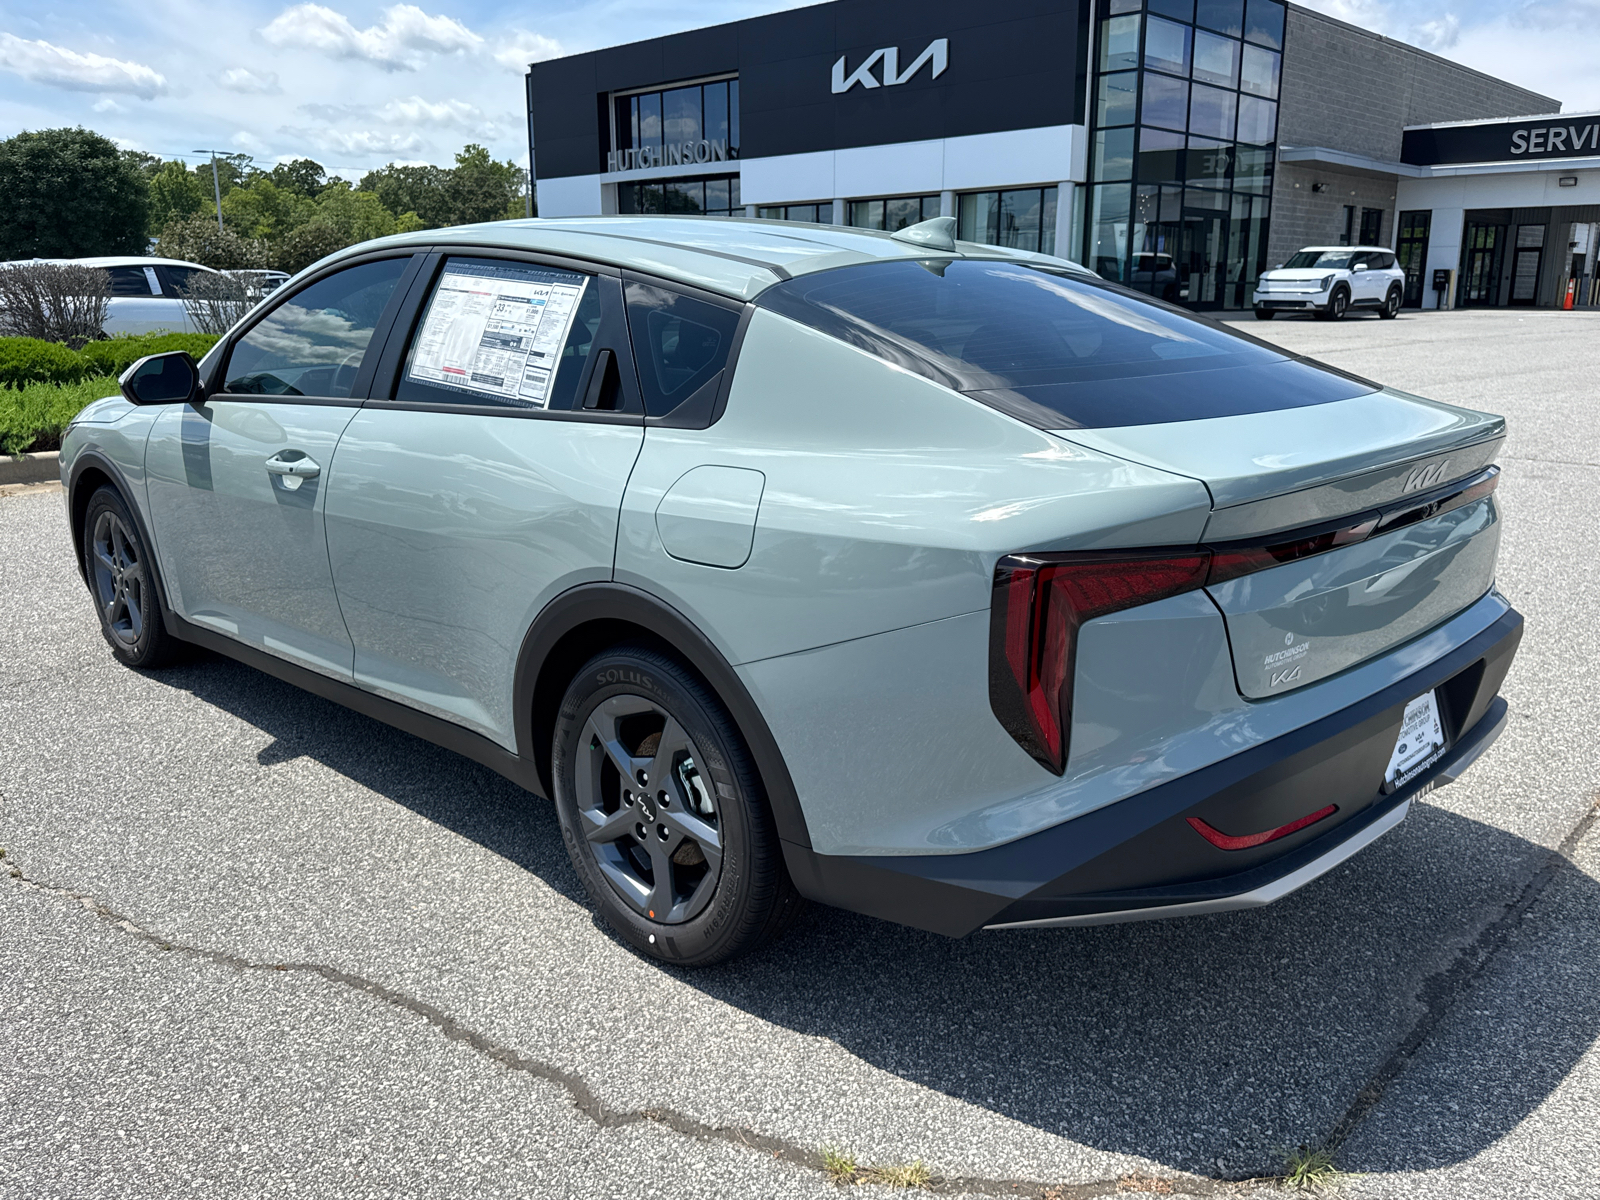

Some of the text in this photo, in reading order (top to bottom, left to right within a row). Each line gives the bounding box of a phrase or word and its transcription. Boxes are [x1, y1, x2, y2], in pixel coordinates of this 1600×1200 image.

[831, 38, 949, 94] KIA
[1510, 124, 1600, 154] SERVI
[607, 138, 727, 173] HUTCHINSON
[496, 303, 506, 312] 33
[1402, 459, 1450, 493] KIA
[1264, 641, 1310, 665] HUTCHINSON
[1264, 651, 1308, 671] AUTOMOTIVE GROUP
[596, 669, 653, 689] SOLUS
[1269, 664, 1302, 688] K4
[1398, 722, 1418, 742] TOMOTIVE
